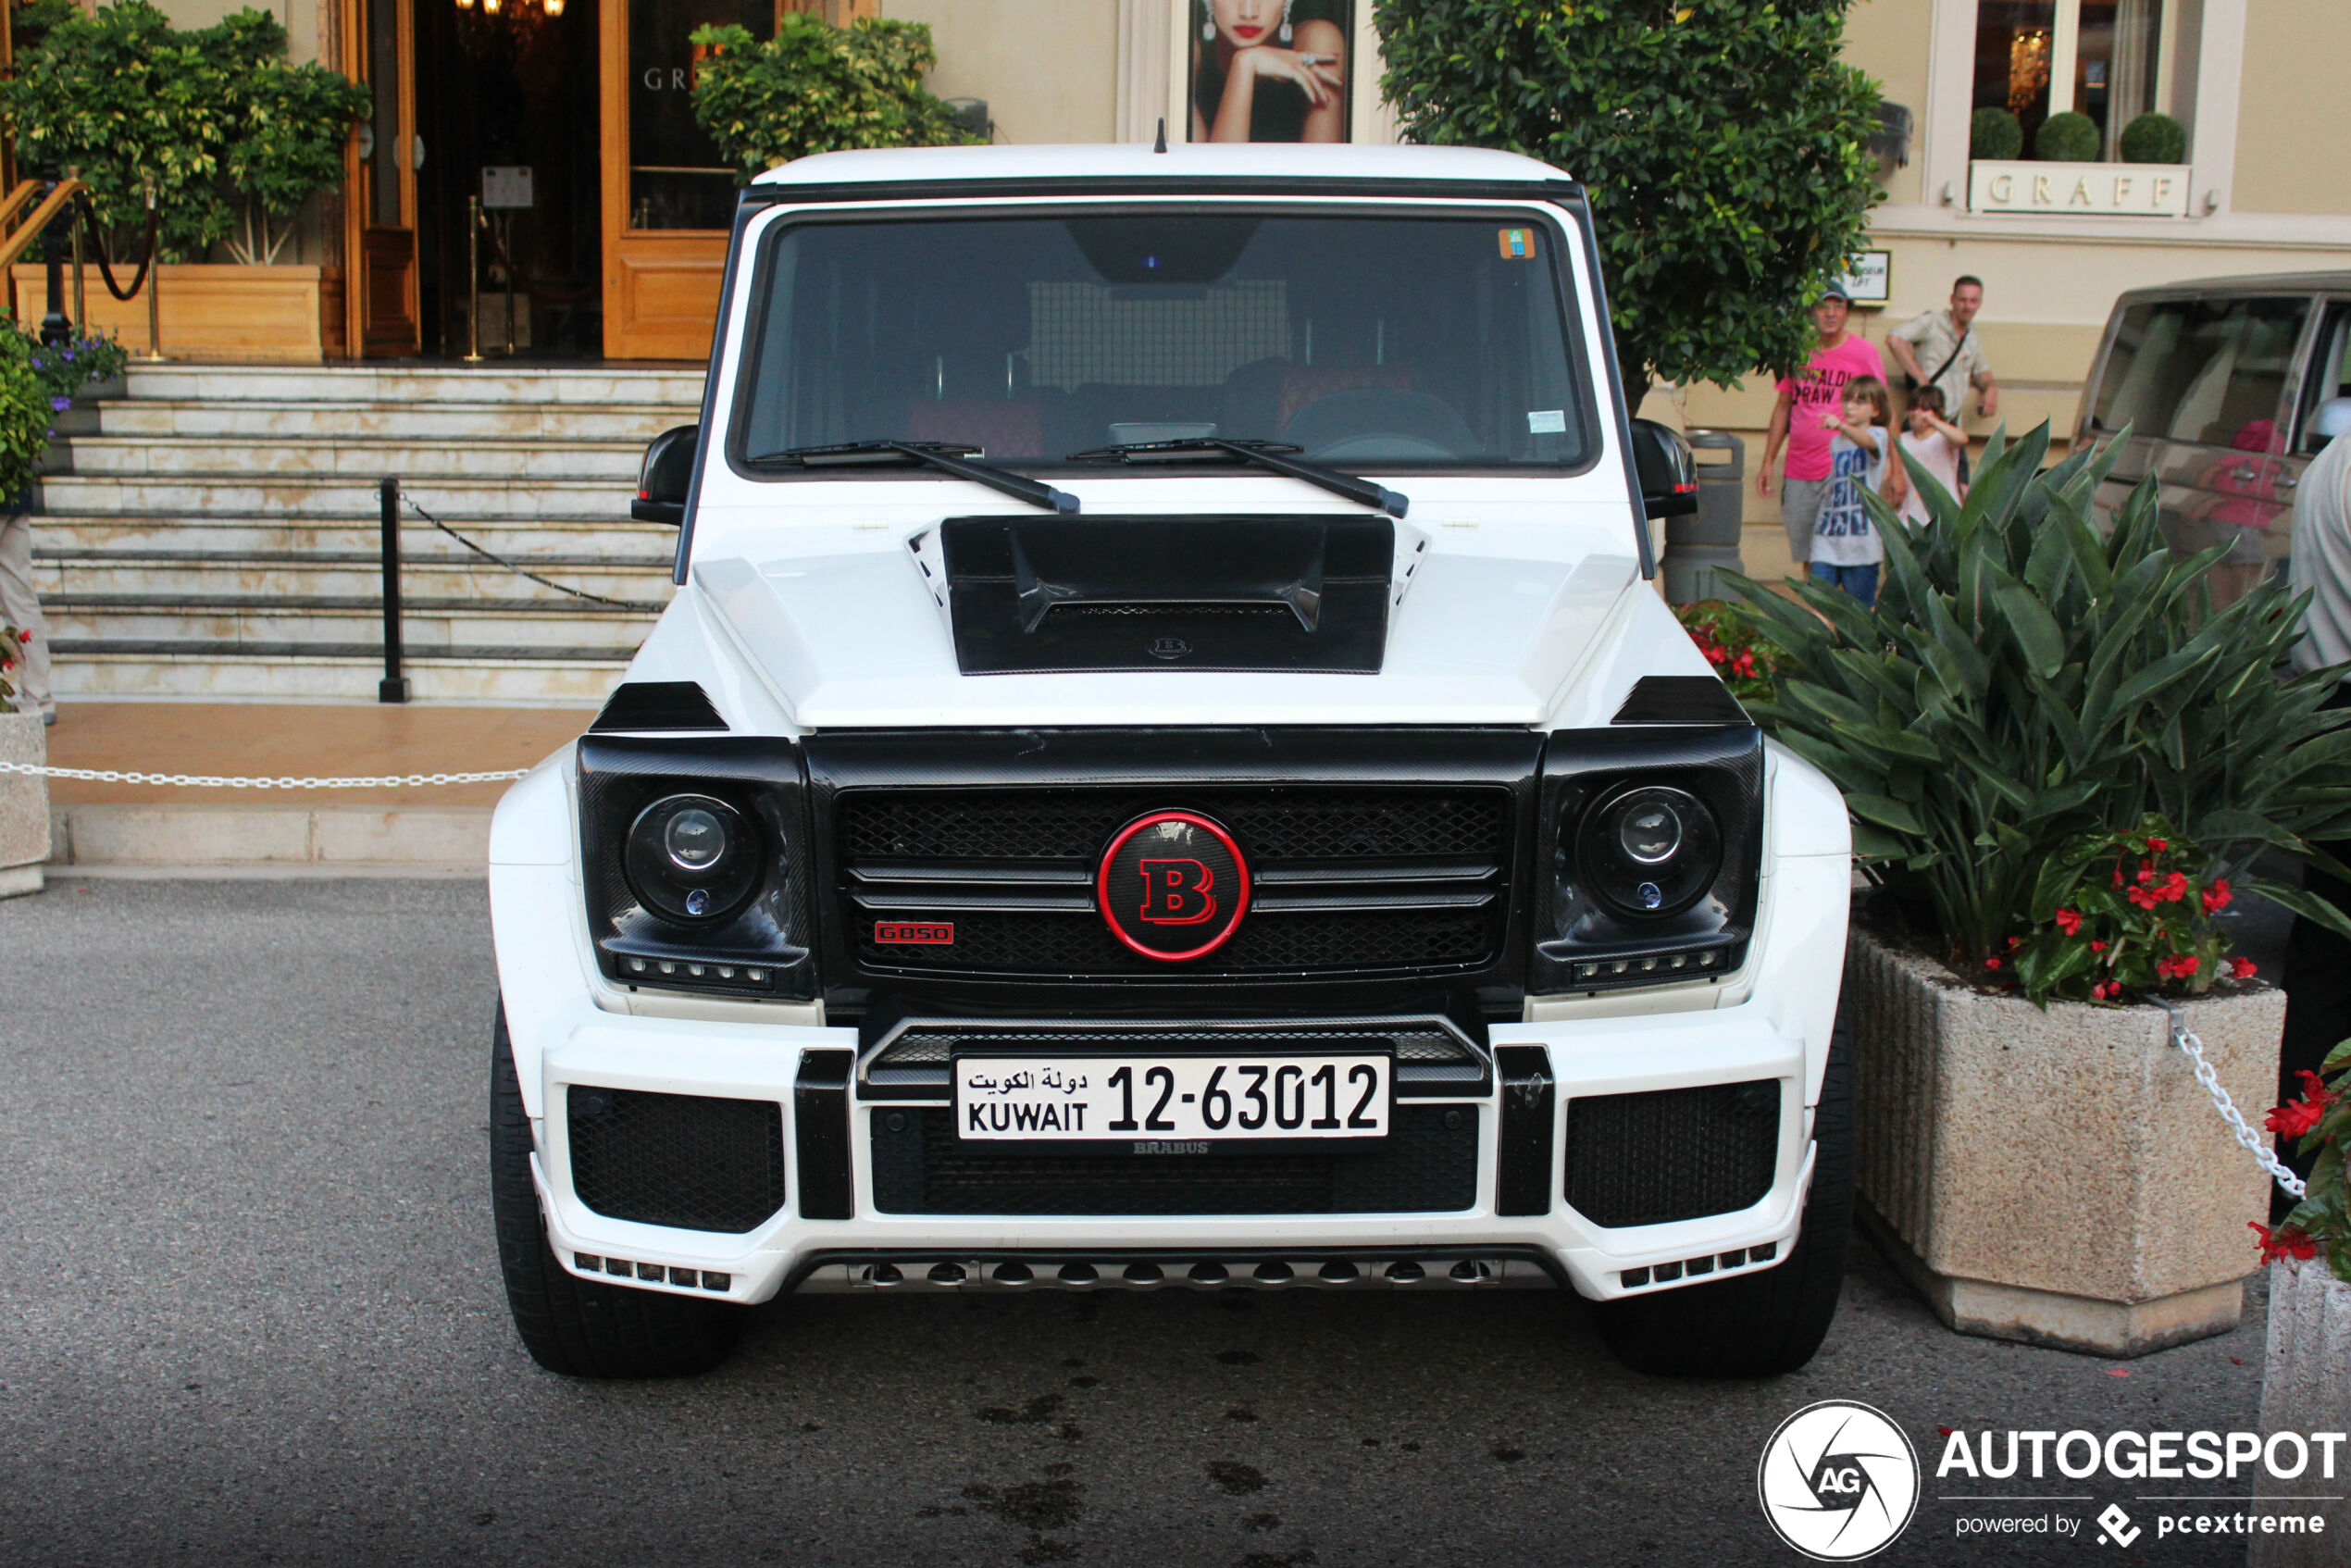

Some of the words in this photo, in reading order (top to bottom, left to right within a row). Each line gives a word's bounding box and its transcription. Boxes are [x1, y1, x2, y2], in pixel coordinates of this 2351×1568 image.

[1991, 175, 2171, 206] GRAFF
[1139, 858, 1217, 925] B
[879, 927, 949, 940] G850
[968, 1070, 1035, 1096] الكويت
[1041, 1066, 1088, 1095] دولة
[1108, 1064, 1377, 1131] 12-63012
[968, 1102, 1088, 1131] KUWAIT
[1134, 1141, 1208, 1154] BRABUS
